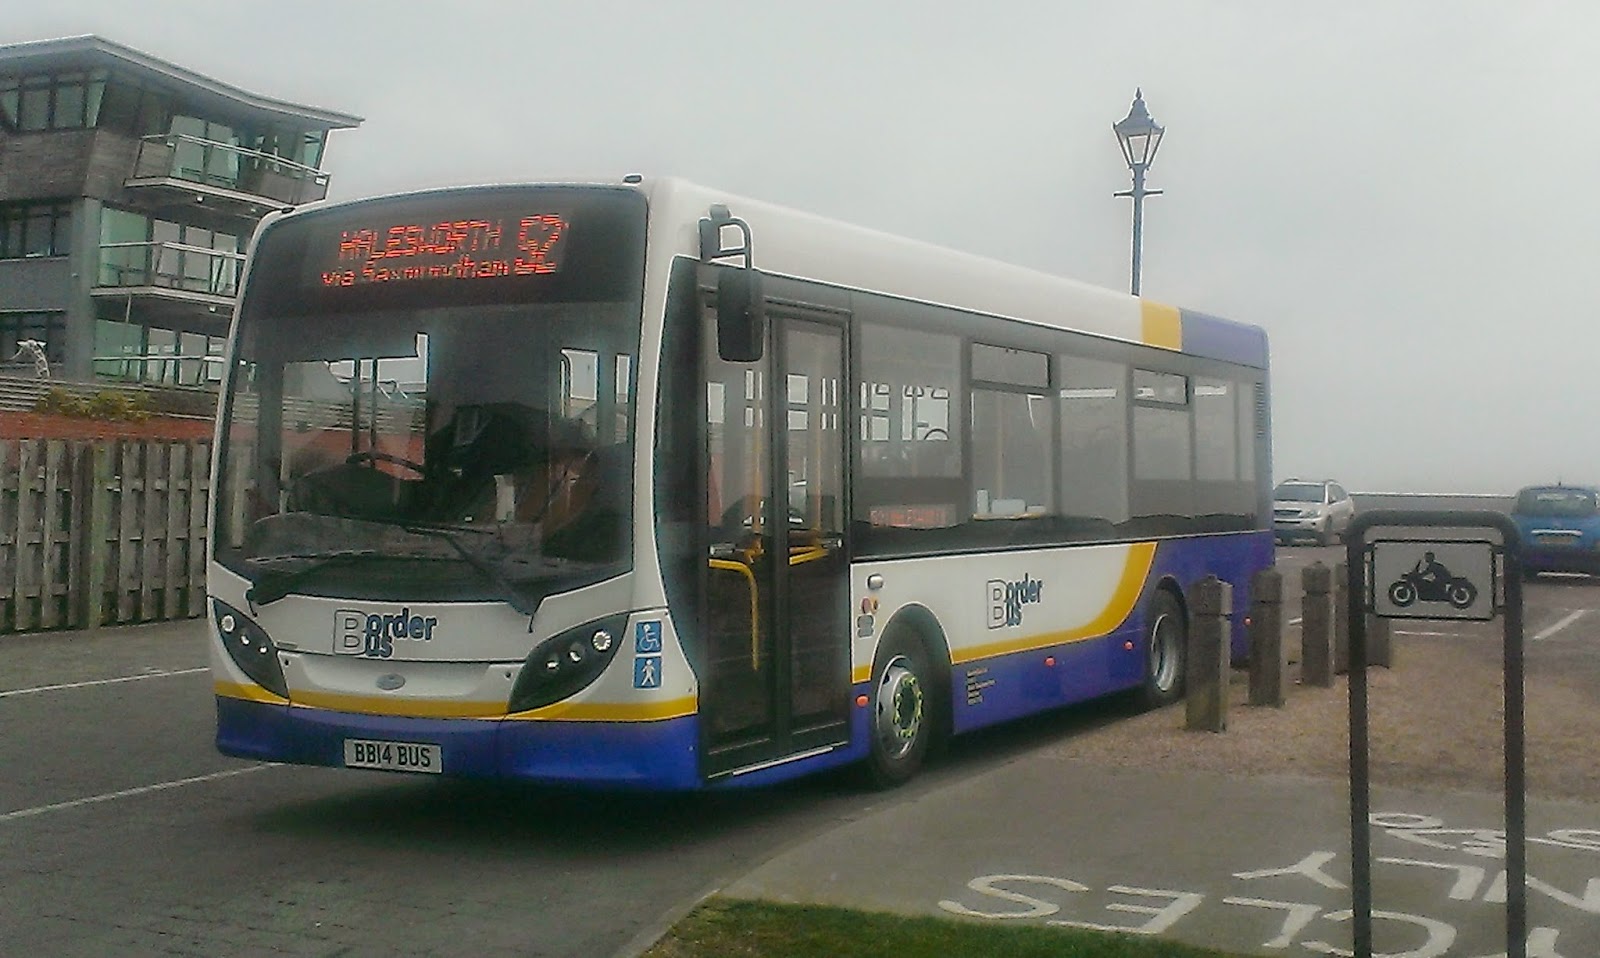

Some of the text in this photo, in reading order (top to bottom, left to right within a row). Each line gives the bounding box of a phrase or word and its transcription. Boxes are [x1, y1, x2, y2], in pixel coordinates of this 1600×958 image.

[338, 219, 503, 260] HALESWORTH
[321, 268, 355, 287] via
[333, 607, 437, 656] Border
[354, 742, 431, 768] BB14 BUS
